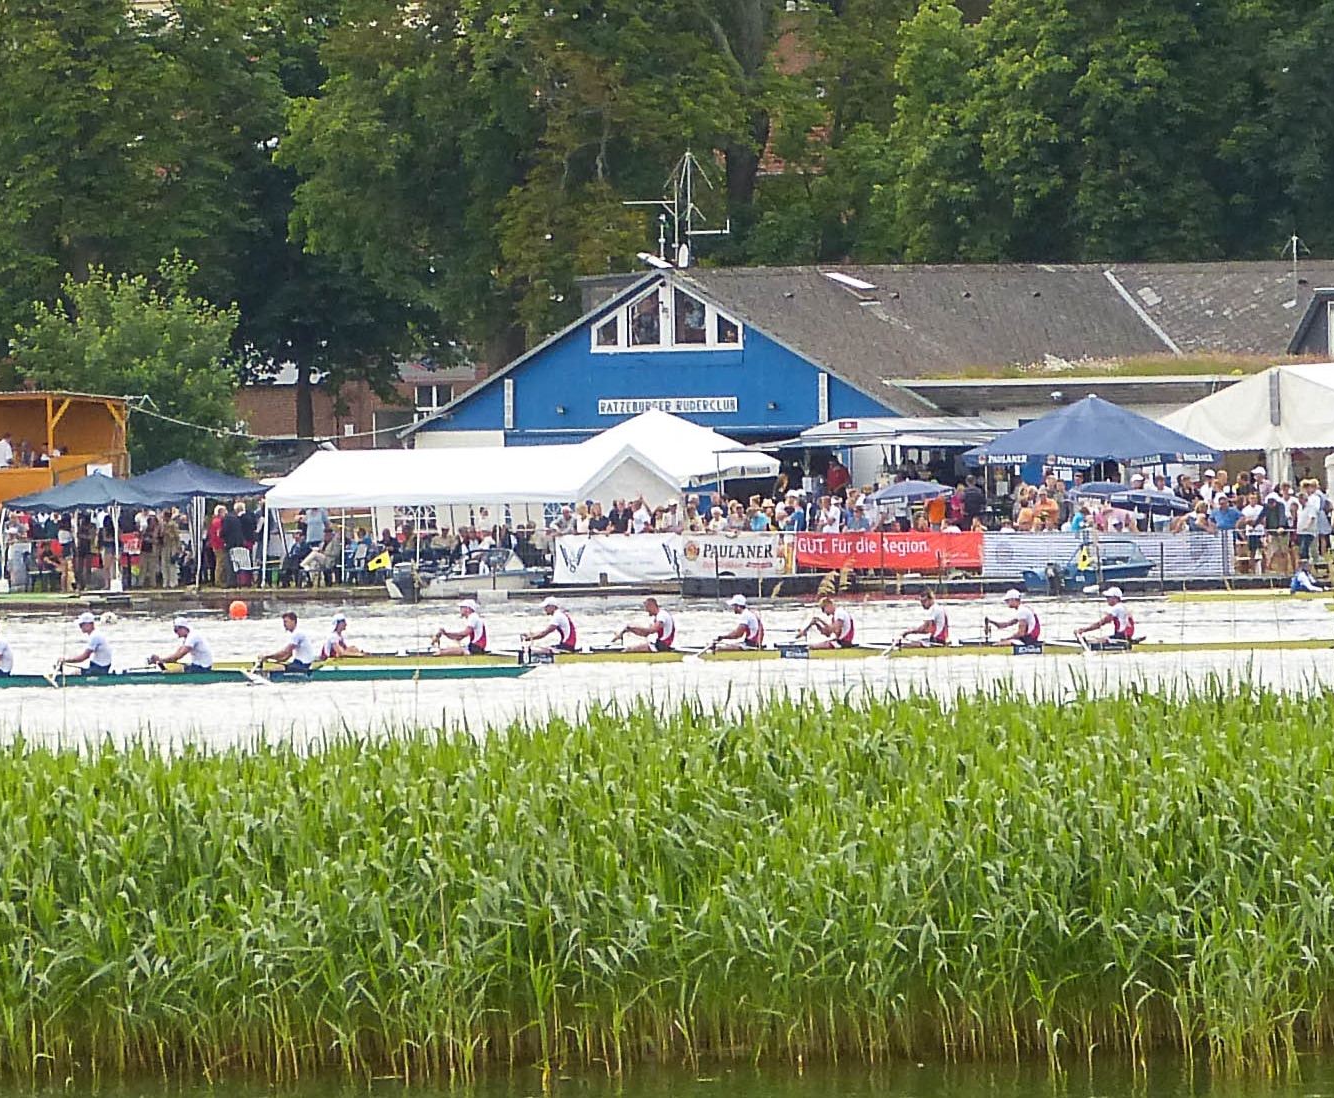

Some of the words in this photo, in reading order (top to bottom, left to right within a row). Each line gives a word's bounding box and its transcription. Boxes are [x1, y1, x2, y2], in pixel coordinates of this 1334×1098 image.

[600, 400, 671, 412] RATZEBURGER
[676, 399, 736, 411] RUDERCLUB
[703, 543, 773, 558] PAULANER
[797, 538, 829, 554] GUT.
[832, 537, 851, 554] Für
[856, 537, 877, 553] die
